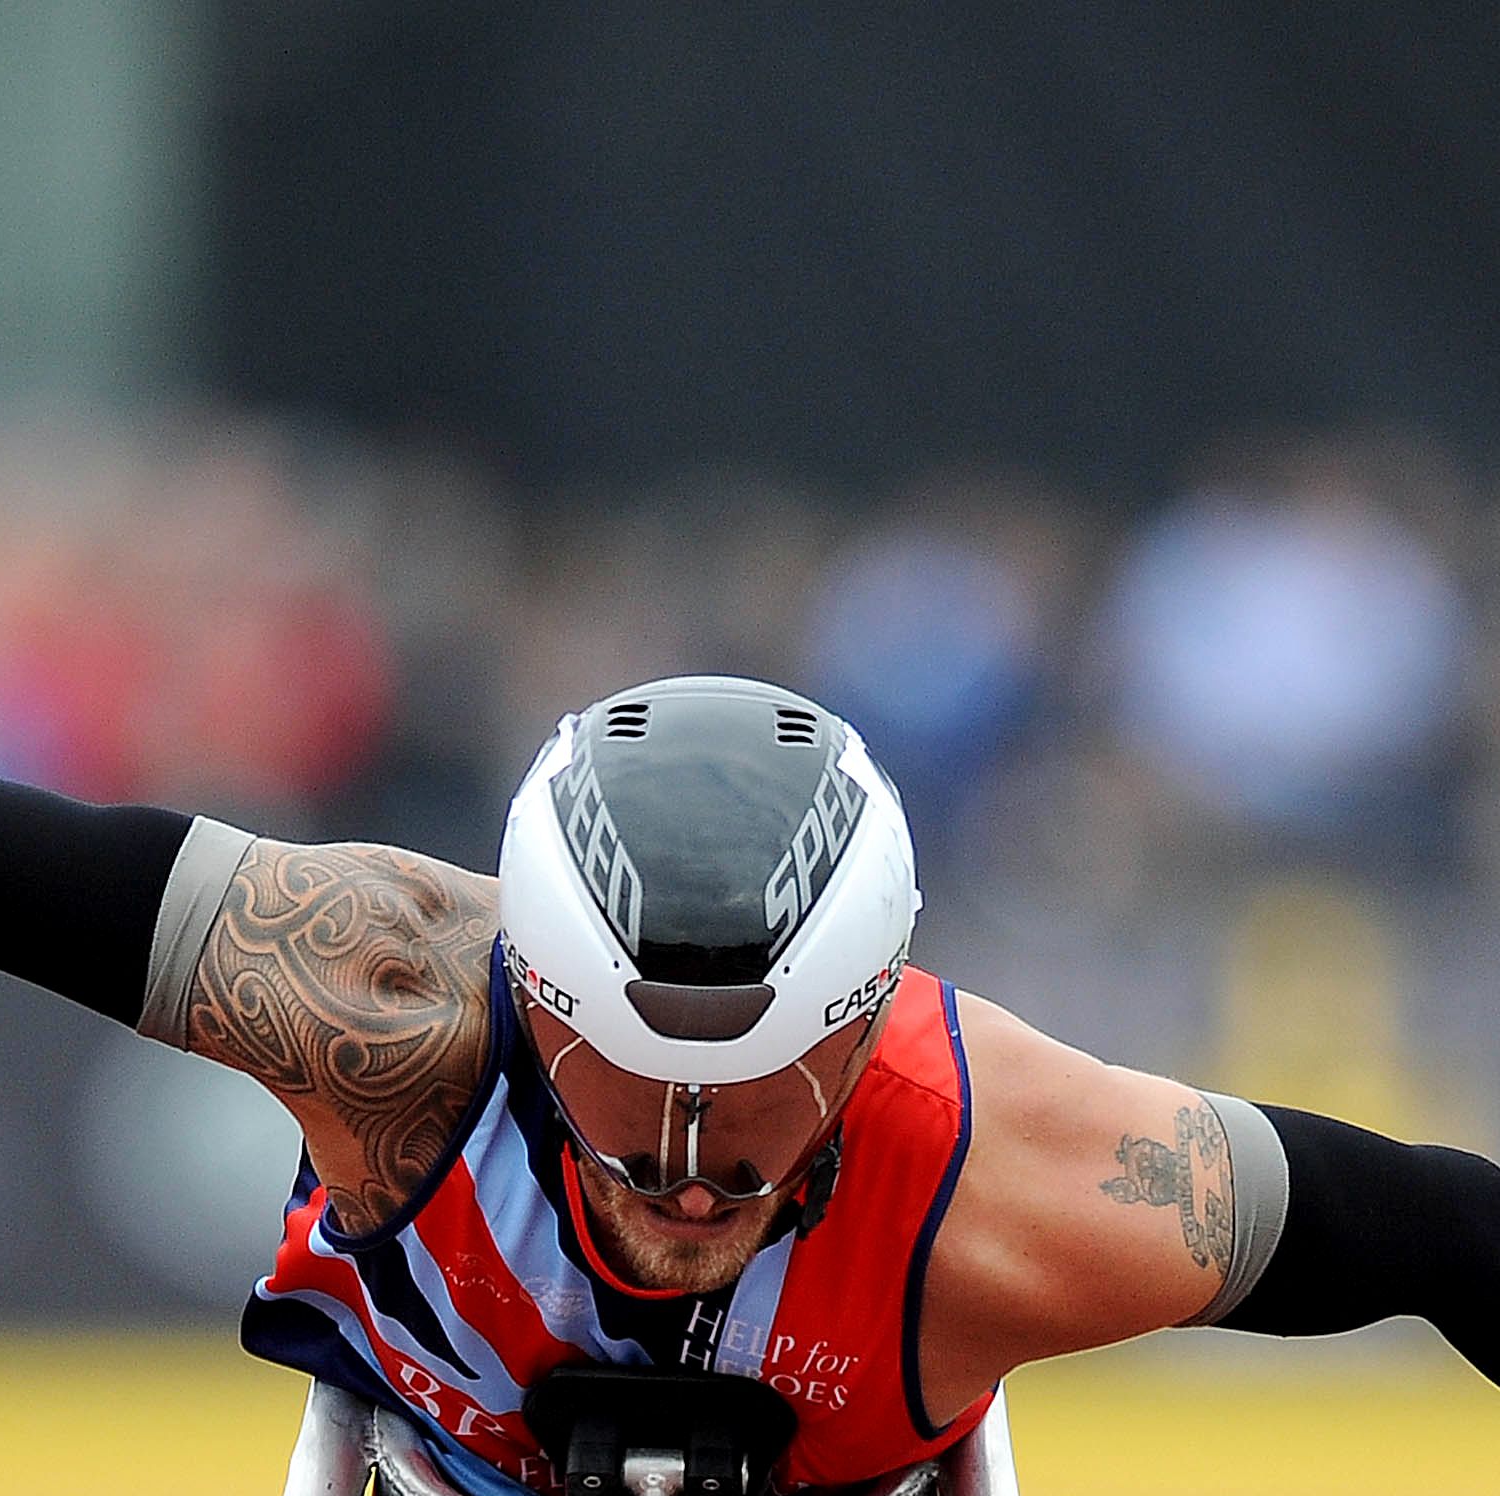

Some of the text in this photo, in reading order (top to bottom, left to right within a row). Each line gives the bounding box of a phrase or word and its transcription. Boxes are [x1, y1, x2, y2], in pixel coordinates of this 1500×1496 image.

[554, 732, 643, 957] PEED
[686, 1299, 860, 1376] HELP for
